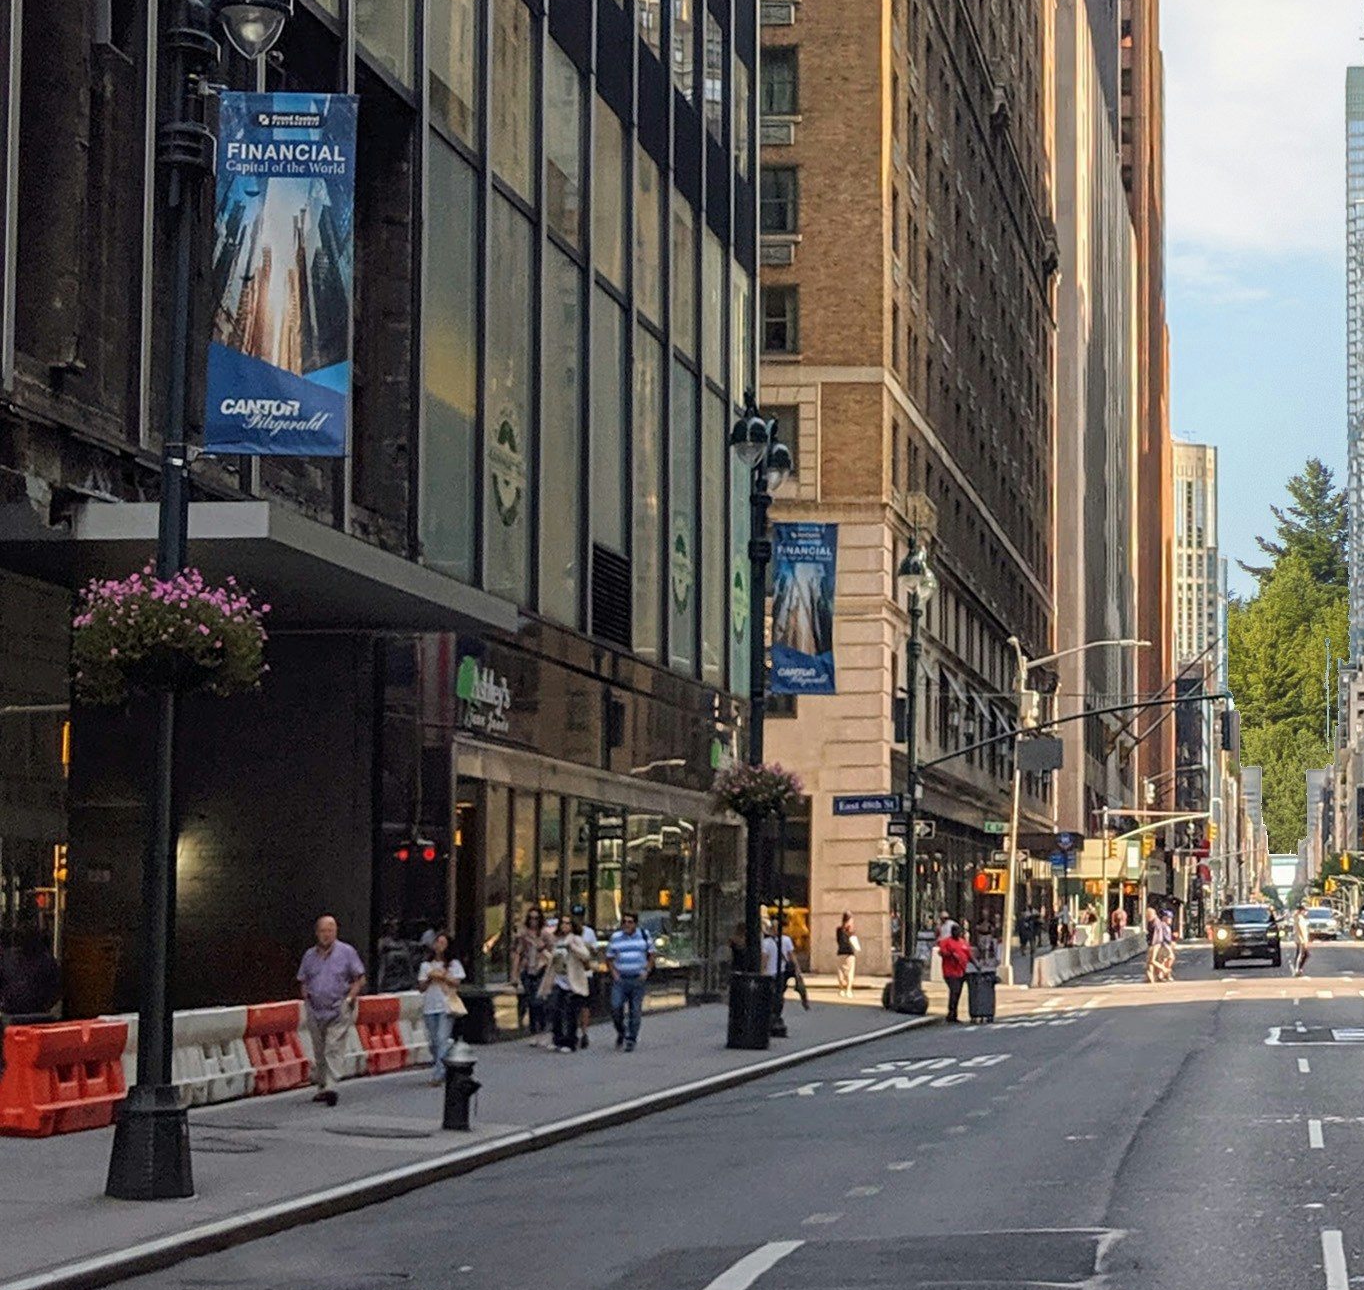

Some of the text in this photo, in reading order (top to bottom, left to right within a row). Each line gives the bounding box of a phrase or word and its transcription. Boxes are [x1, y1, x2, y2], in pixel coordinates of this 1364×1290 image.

[227, 142, 346, 161] FINANCIAL
[225, 160, 345, 174] Capital of the World
[220, 399, 300, 417] CANTOR
[242, 411, 329, 437] Fitzgerald
[777, 545, 832, 557] FINANCIAL
[839, 801, 860, 811] East
[883, 798, 895, 809] St
[861, 1053, 1013, 1074] BUS
[768, 1072, 978, 1098] ONLY
